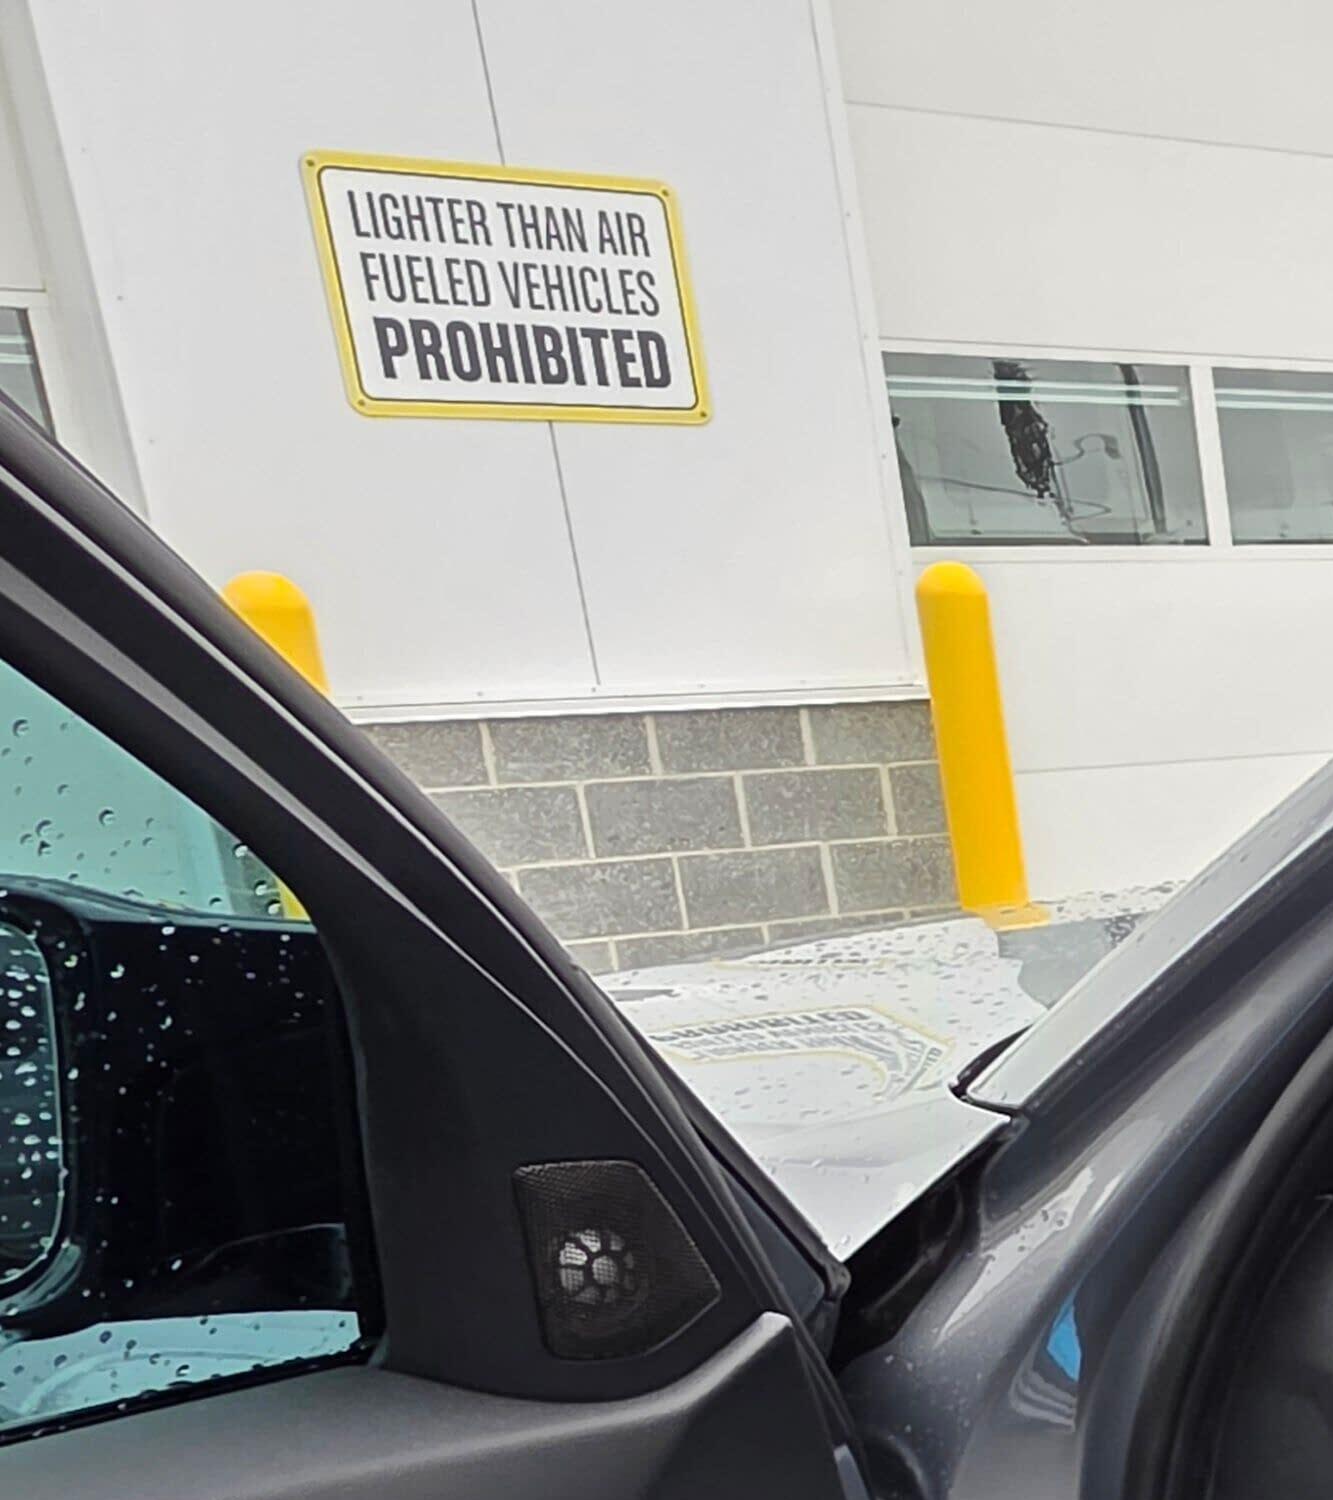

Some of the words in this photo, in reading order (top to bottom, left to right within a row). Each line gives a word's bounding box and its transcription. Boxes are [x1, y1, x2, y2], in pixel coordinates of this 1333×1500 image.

[347, 190, 493, 247] LIGHTER
[497, 202, 588, 253] THAN
[598, 210, 651, 257] AIR
[360, 252, 491, 307] FUELED
[498, 261, 660, 317] VEHICLES
[373, 316, 672, 389] PROHIBITED
